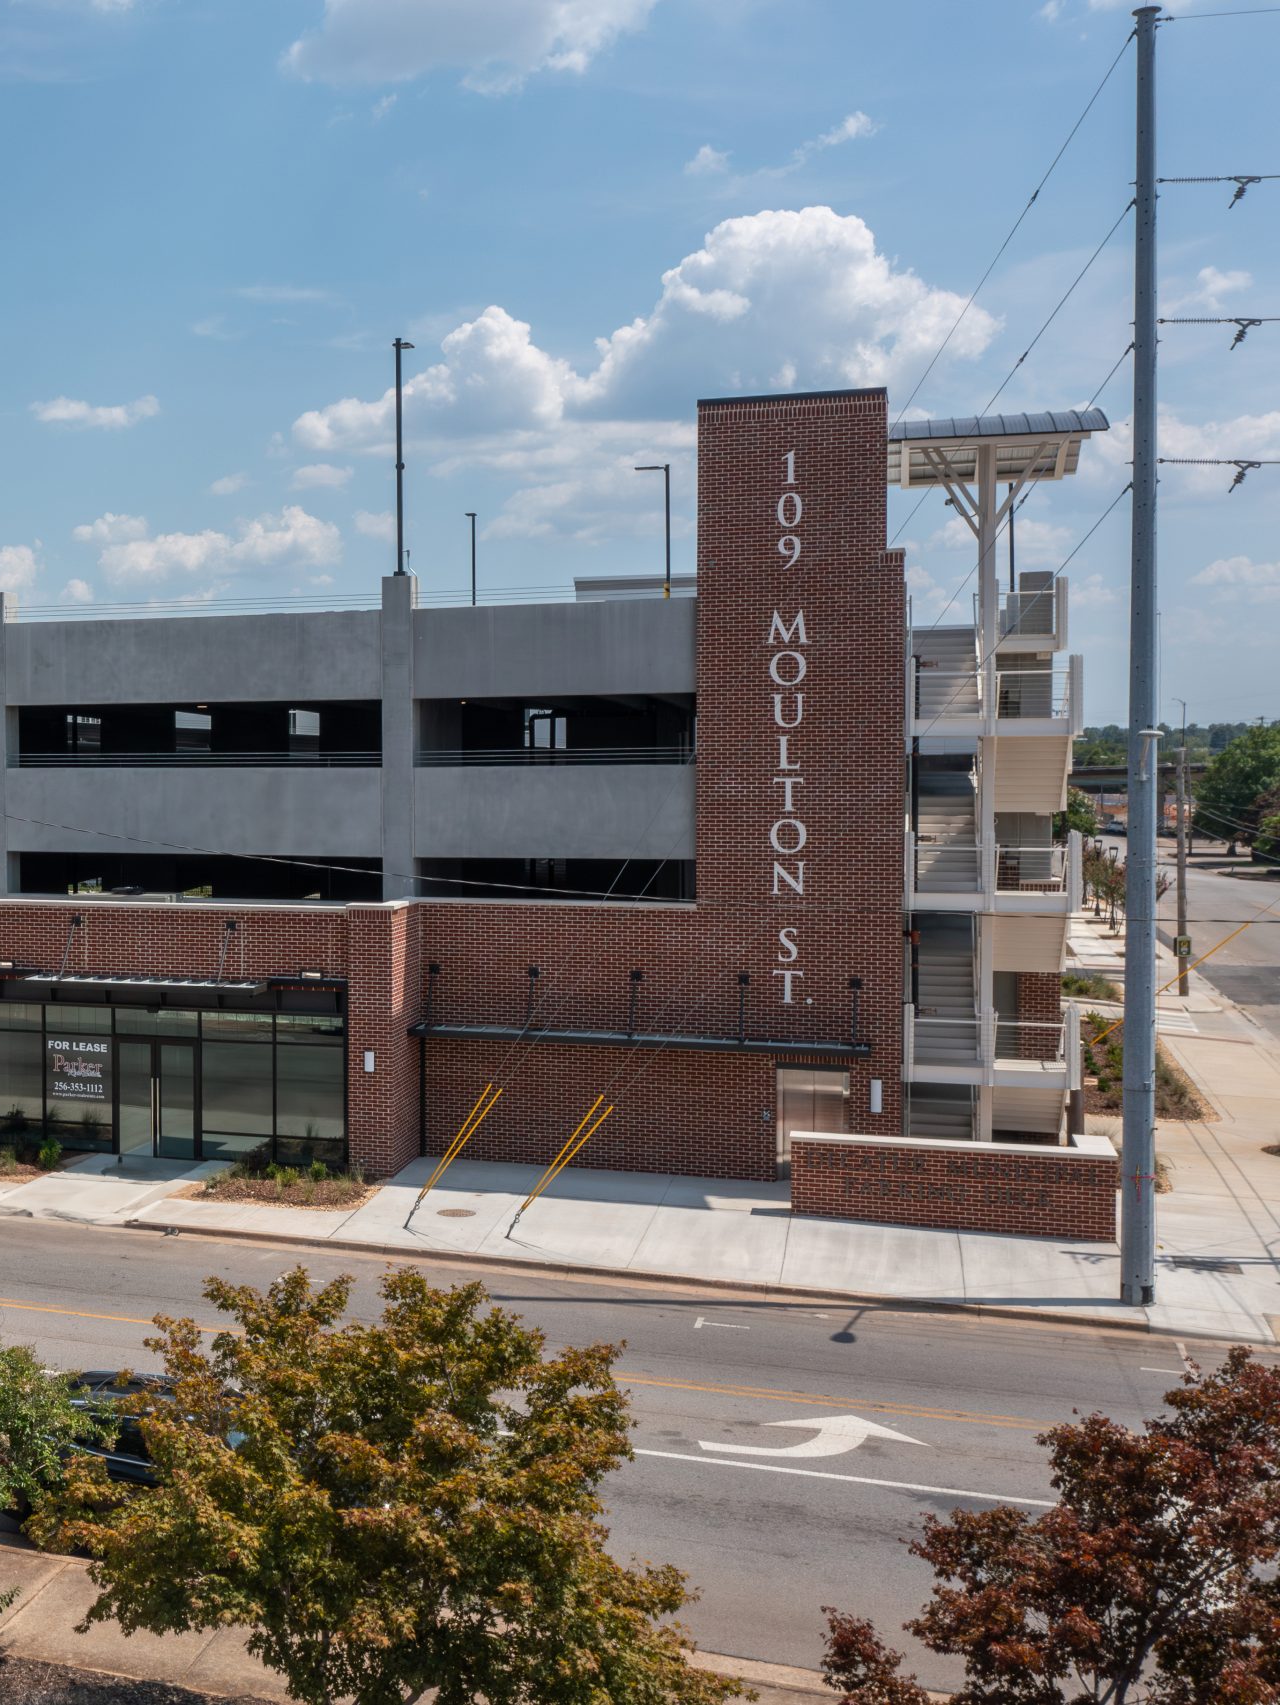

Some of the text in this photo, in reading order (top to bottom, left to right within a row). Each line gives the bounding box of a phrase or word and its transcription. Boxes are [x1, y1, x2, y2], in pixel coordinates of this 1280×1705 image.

[766, 449, 813, 1004] 109 MOULTON ST.
[48, 1040, 108, 1053] FOR LEASE
[52, 1053, 104, 1073] Parker
[54, 1081, 103, 1093] 256-353-1112
[845, 1176, 971, 1203] PARKING
